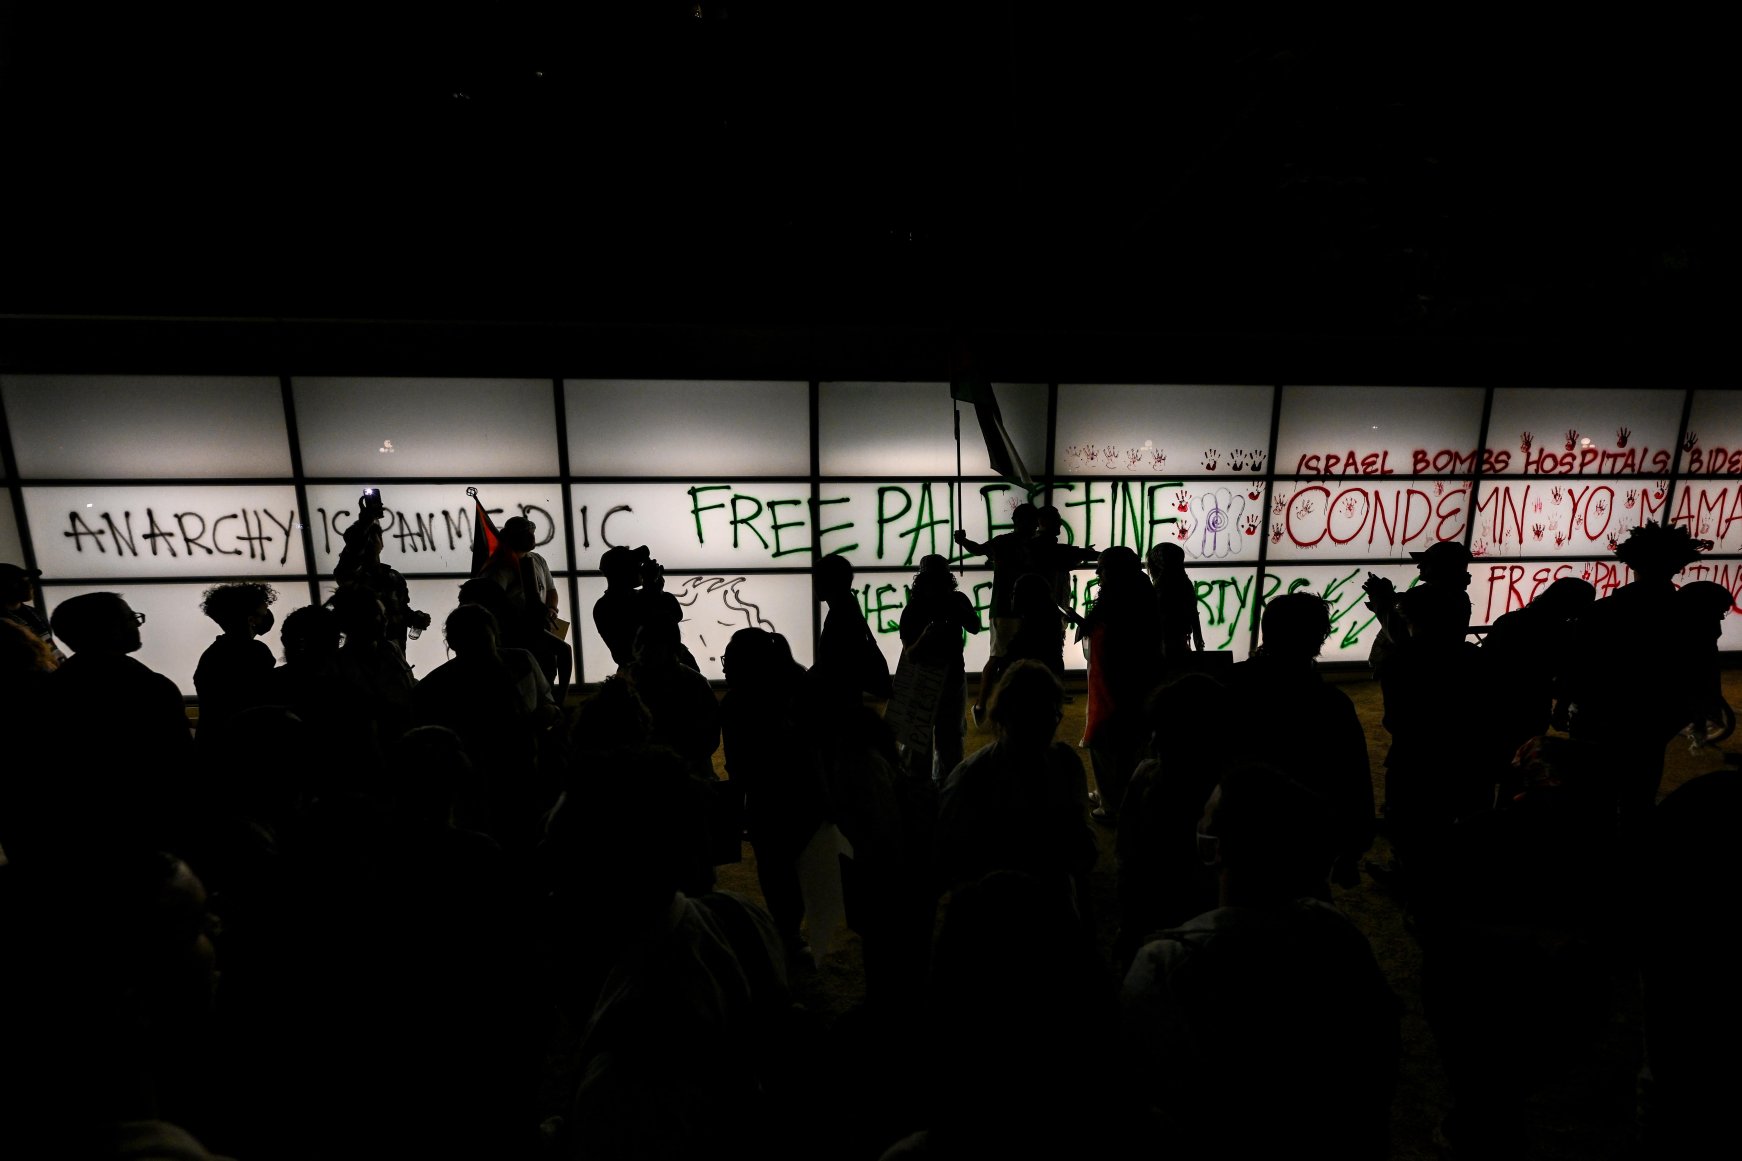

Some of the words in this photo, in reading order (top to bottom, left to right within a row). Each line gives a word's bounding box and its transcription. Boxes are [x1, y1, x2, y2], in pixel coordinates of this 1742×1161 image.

[1294, 450, 1394, 478] ISRAEL
[1412, 449, 1511, 476] BOMBS
[65, 508, 295, 566] ANARCHY
[687, 484, 859, 560] FREE
[1286, 485, 1531, 546] CONDEMN
[1567, 485, 1615, 541] YO
